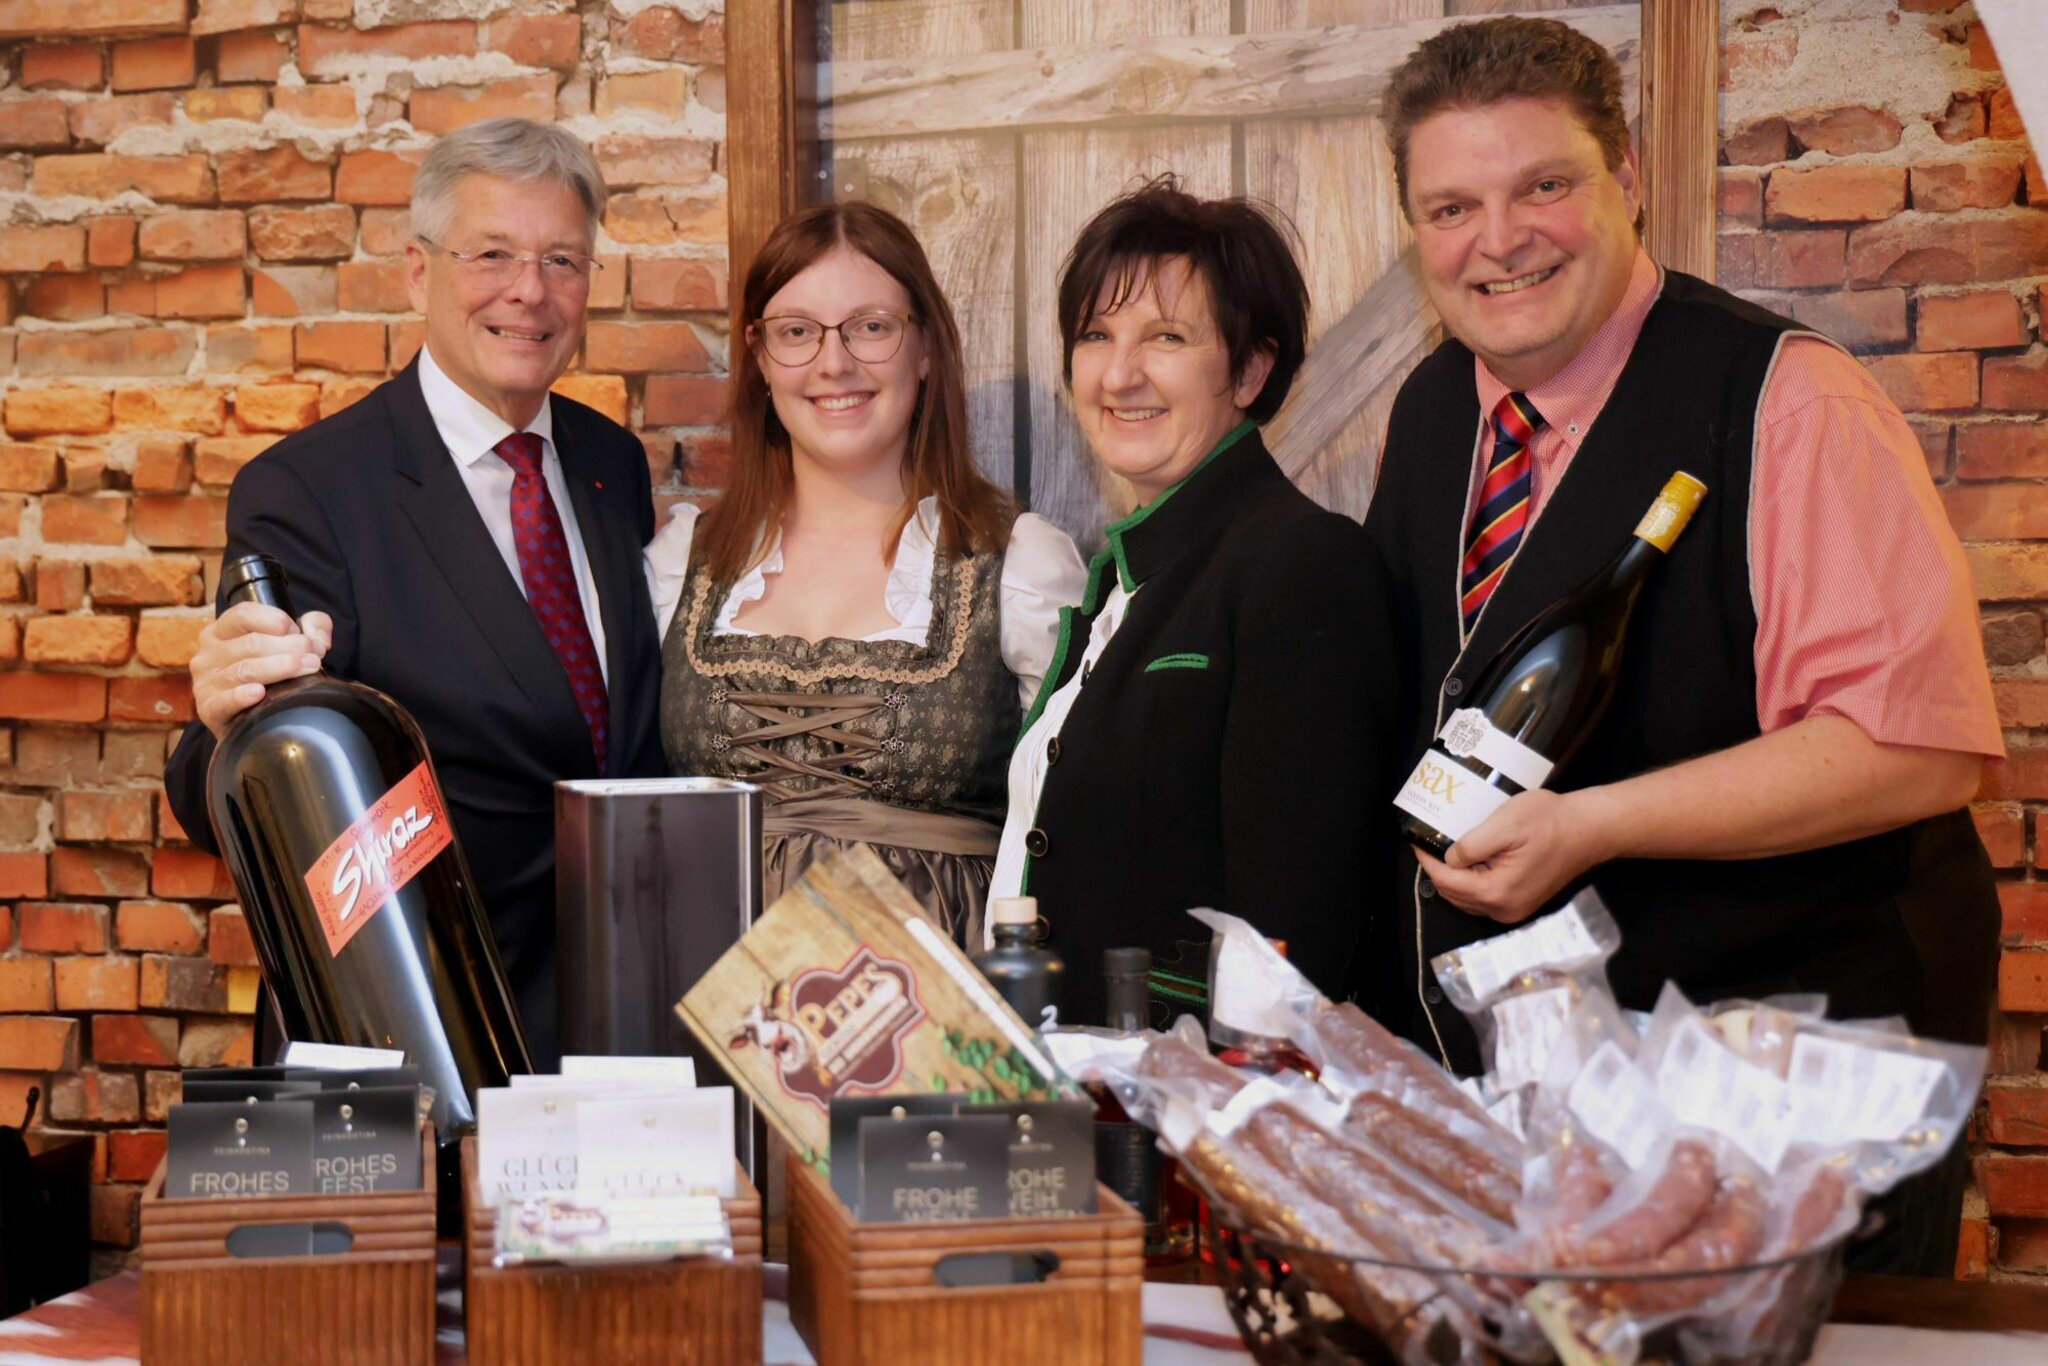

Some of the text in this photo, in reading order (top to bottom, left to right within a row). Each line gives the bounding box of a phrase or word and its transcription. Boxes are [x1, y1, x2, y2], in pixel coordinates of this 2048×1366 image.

[1412, 761, 1466, 805] sax
[332, 805, 433, 923] Shiraz
[314, 1153, 397, 1178] ROHES
[190, 1170, 290, 1194] FROHES
[893, 1186, 979, 1210] FROHE
